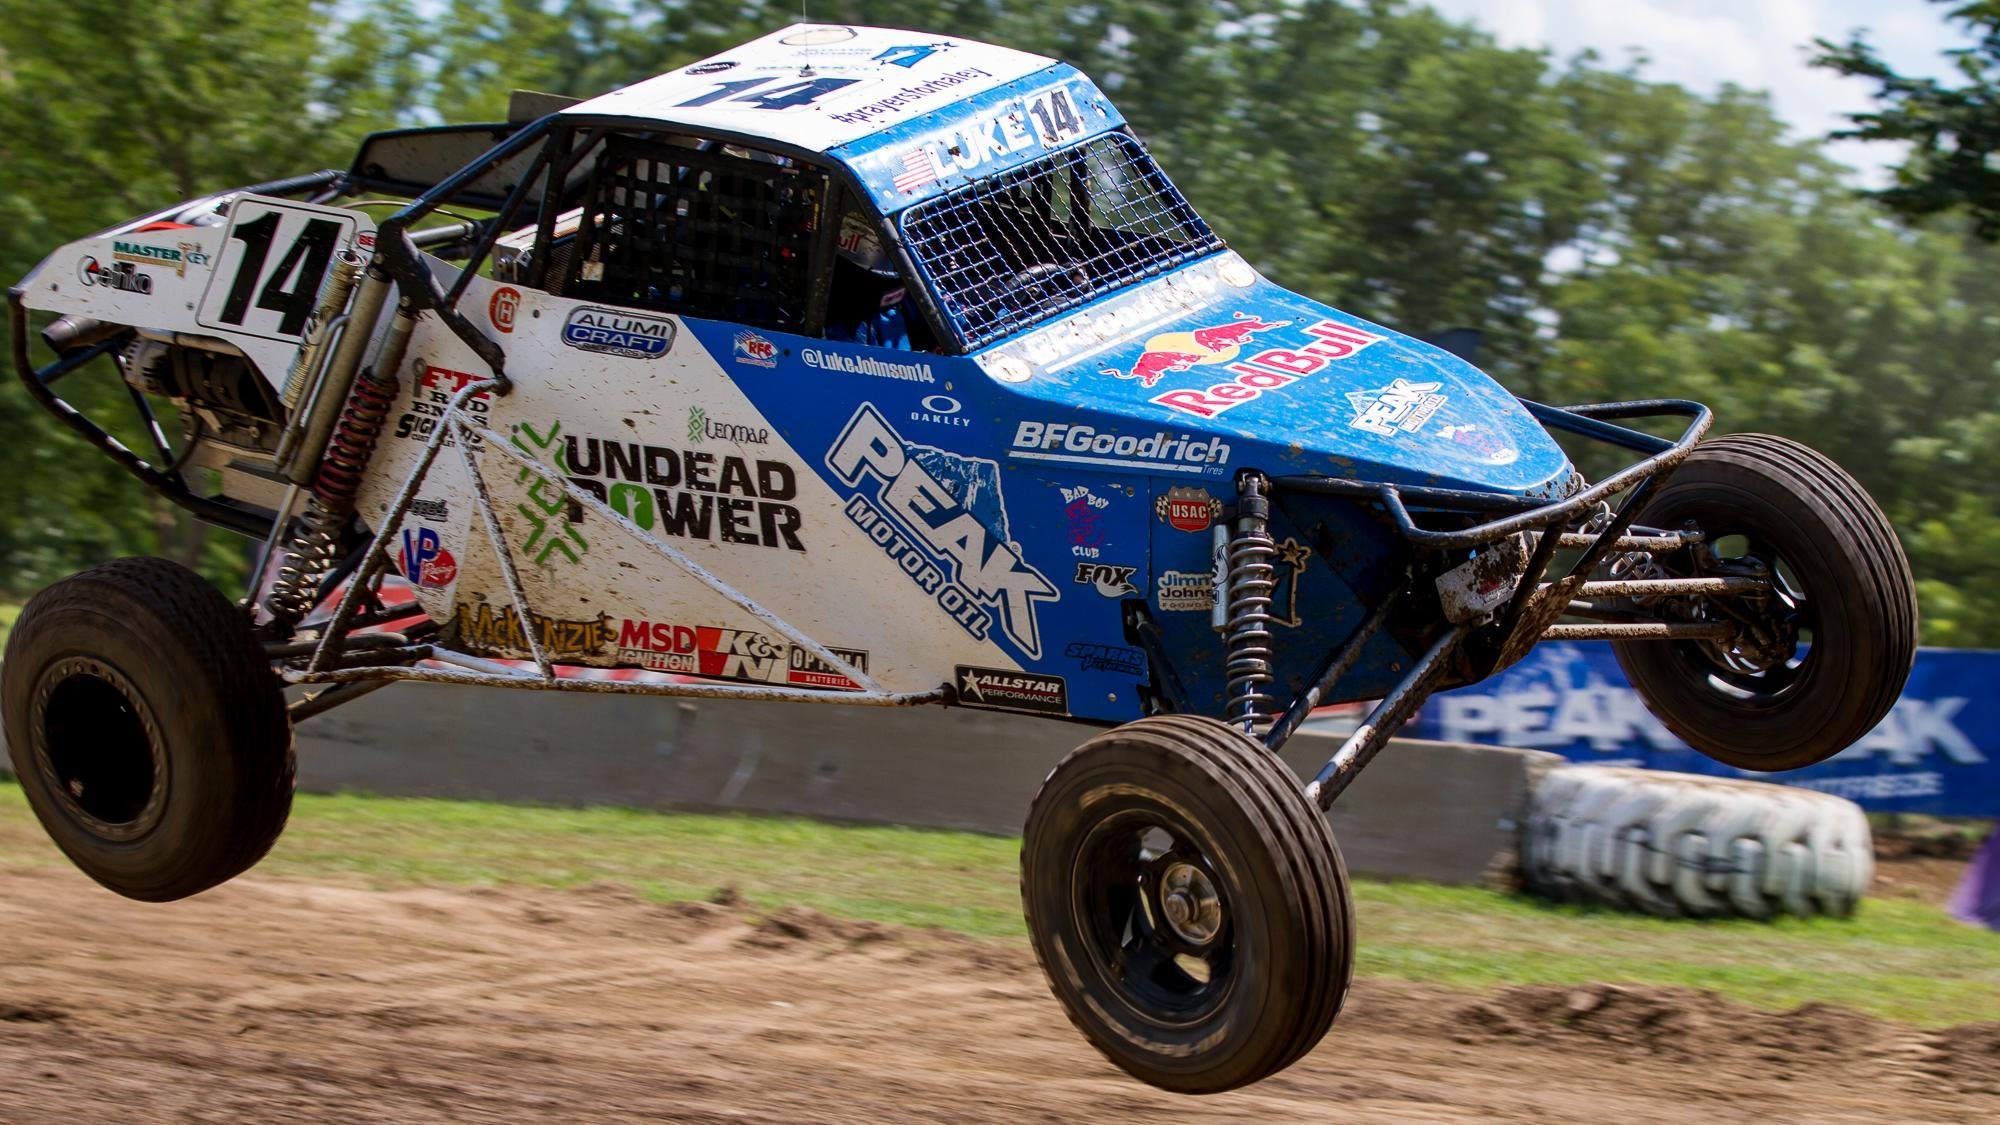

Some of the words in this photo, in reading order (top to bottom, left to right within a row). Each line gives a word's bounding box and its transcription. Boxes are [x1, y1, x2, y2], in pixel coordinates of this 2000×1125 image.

[672, 76, 863, 110] 14
[828, 67, 993, 125] #prayersforhaley
[922, 108, 1035, 179] LUKE
[1029, 89, 1082, 143] 14
[113, 241, 181, 261] MASTER
[219, 210, 343, 337] 14
[572, 327, 662, 350] CRAFT
[577, 313, 668, 337] ALUMI
[801, 348, 936, 384] @LukeJohnson14
[1150, 362, 1297, 418] Red
[1247, 320, 1386, 376] Bull
[911, 411, 970, 427] OAKLEY
[1350, 378, 1444, 437] PEAK
[1012, 421, 1231, 464] BFGoodrich
[565, 435, 797, 502] UNDEAD
[1203, 464, 1224, 476] Tires
[565, 476, 807, 552] POWER
[1060, 485, 1089, 504] BAD
[1087, 493, 1110, 509] BOY
[1172, 504, 1207, 519] USAC
[824, 401, 1060, 660] PEAK
[403, 527, 440, 585] VP
[846, 495, 944, 595] MOTOR
[939, 583, 991, 640] OIL
[1072, 545, 1100, 558] CLUB
[1075, 563, 1136, 586] FOX
[1161, 587, 1213, 598] Johns
[619, 619, 697, 654] MSD
[805, 674, 851, 687] BATTERIES
[980, 674, 1062, 694] ALLSTAR
[981, 687, 1062, 705] PERFORMANCE
[1442, 687, 1692, 750] PEAK
[1830, 696, 1989, 765] AK
